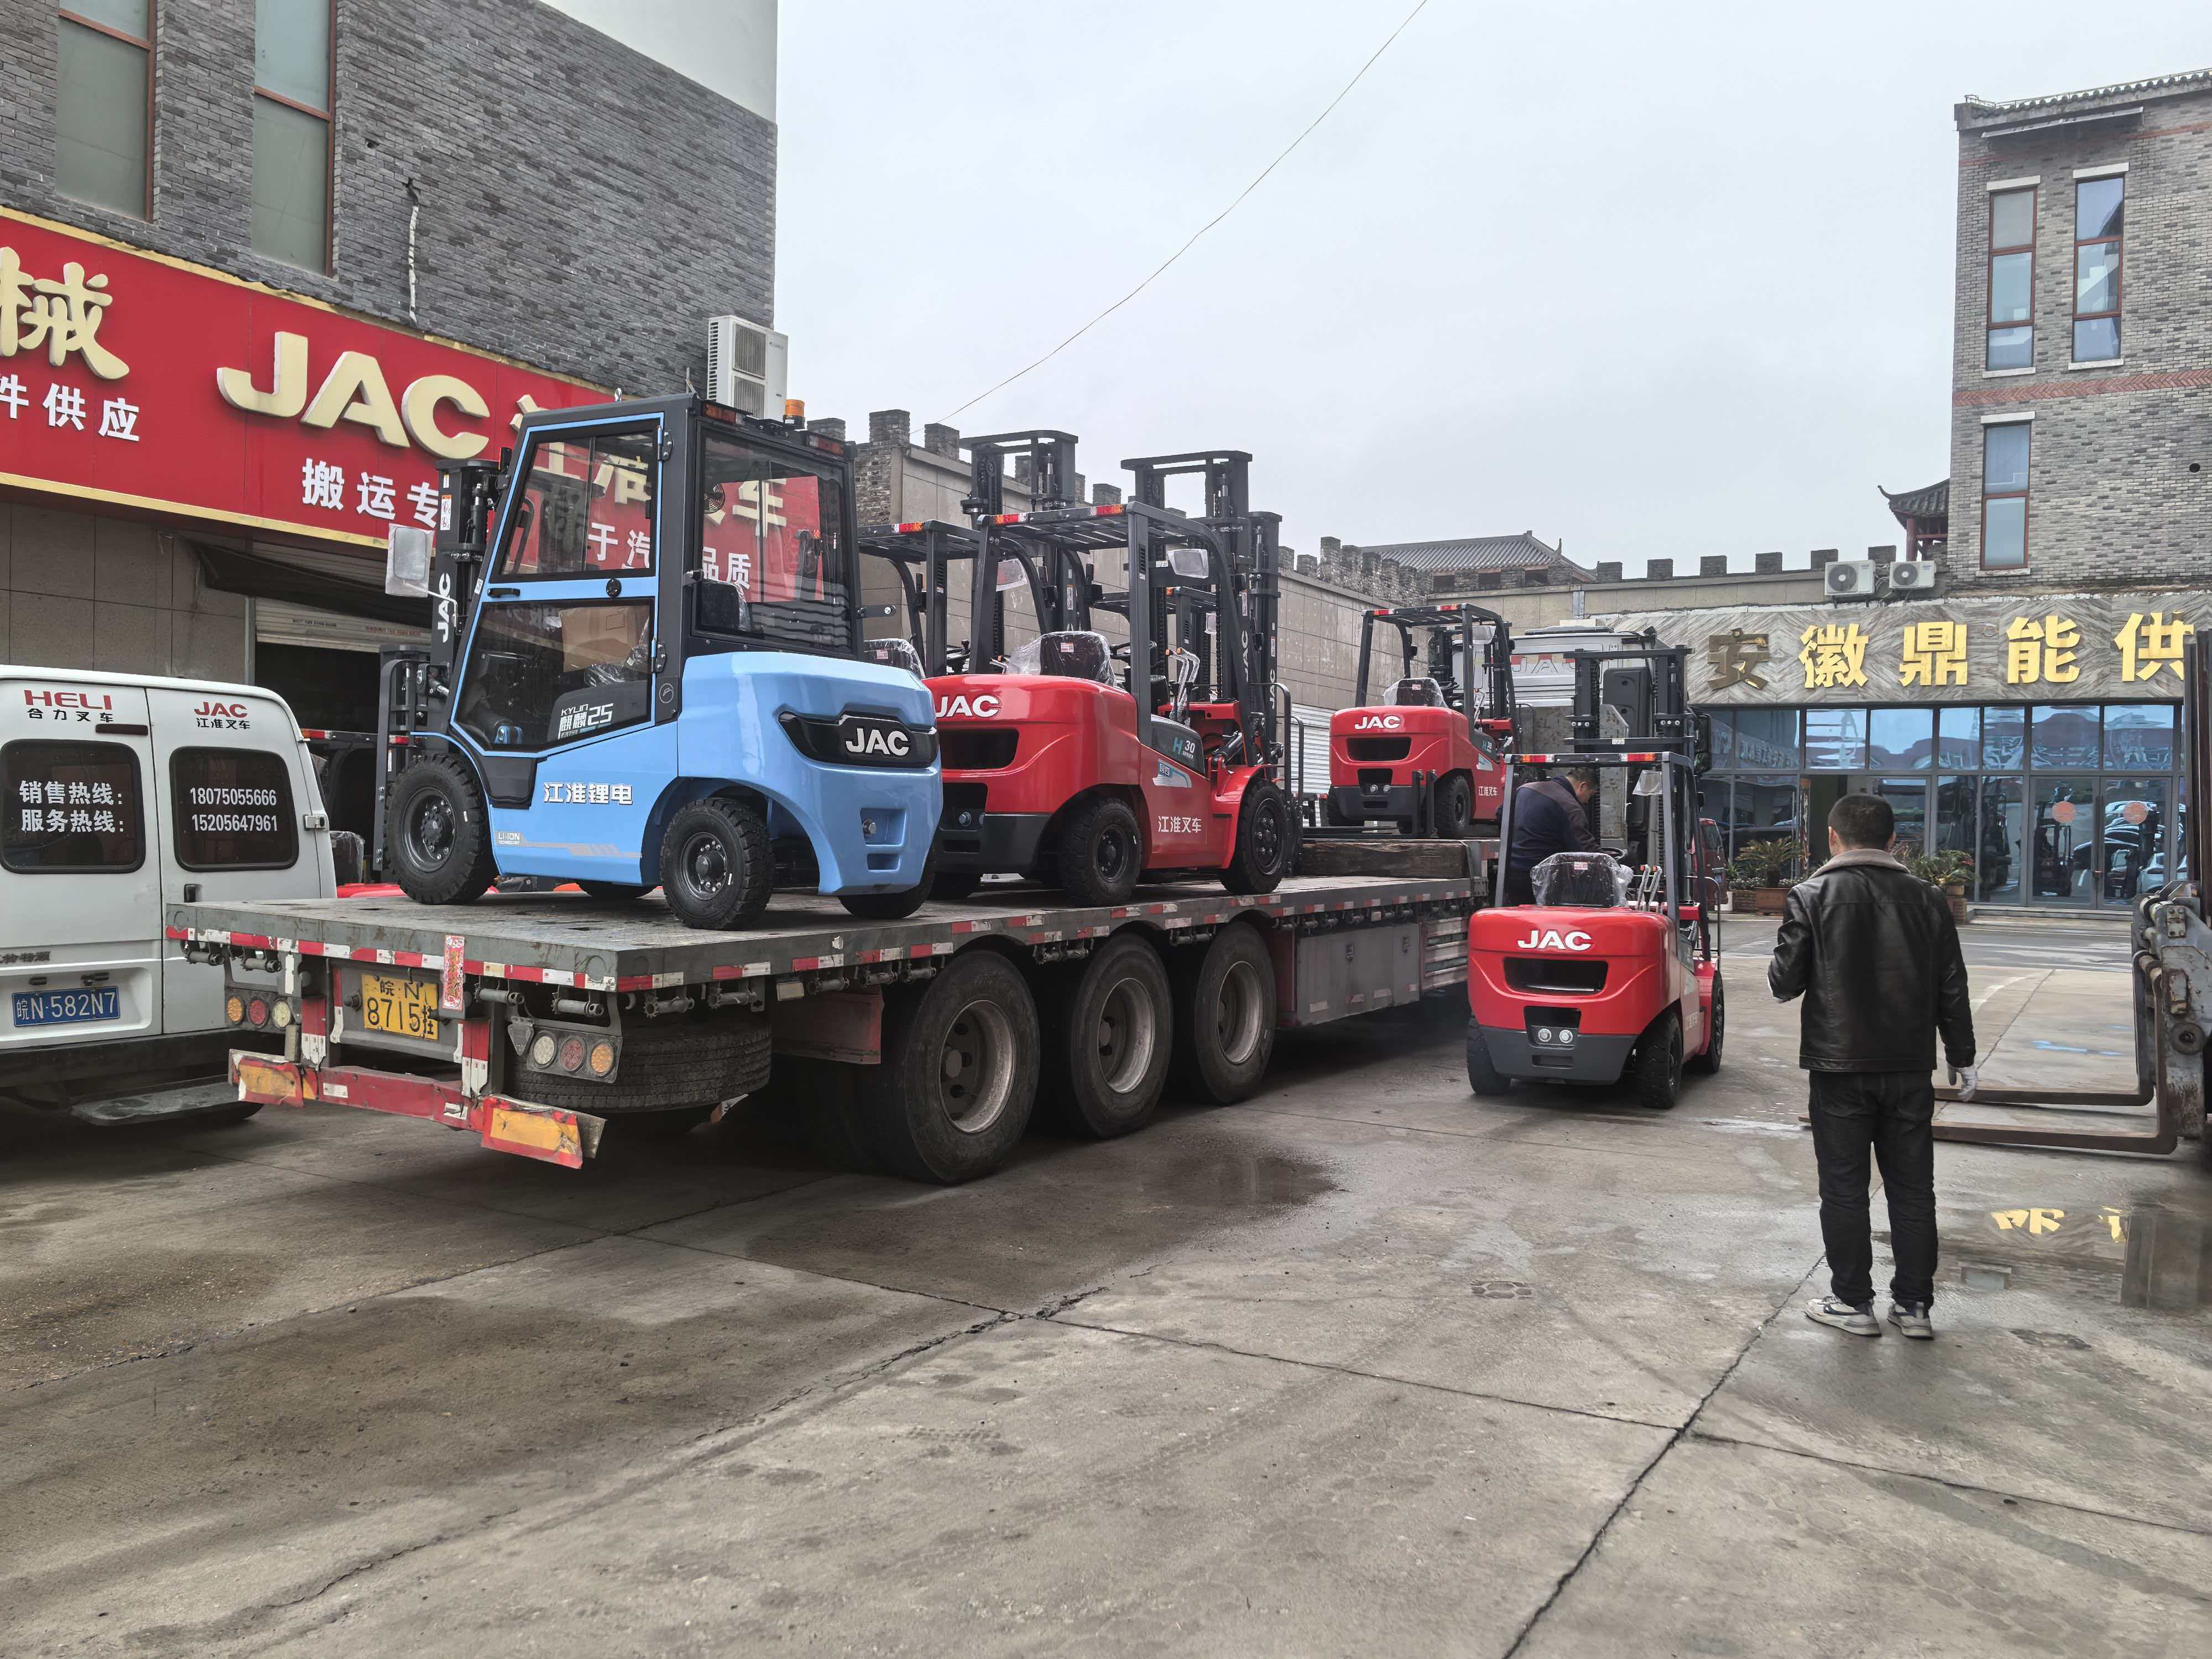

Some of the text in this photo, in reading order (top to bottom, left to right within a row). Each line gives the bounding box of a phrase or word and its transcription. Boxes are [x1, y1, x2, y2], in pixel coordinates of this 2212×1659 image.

[216, 331, 489, 459] JAC
[437, 572, 451, 643] JAC
[1707, 612, 2194, 691] 安徽鼎能供
[24, 690, 112, 710] HELI
[194, 701, 248, 718] JAC
[936, 695, 1001, 718] JAC
[27, 708, 114, 723] 合力叉车
[196, 718, 251, 729] 江淮叉车
[587, 703, 614, 726] 25
[1354, 716, 1402, 729] JAC
[845, 728, 910, 756] JAC
[1172, 737, 1184, 755] H
[1185, 740, 1196, 754] 30
[190, 787, 277, 806] 18075055666
[544, 782, 633, 805] 江淮锂电
[192, 814, 278, 832] 15205647961
[1158, 816, 1202, 833] 江淮叉车
[1517, 930, 1594, 951] JAC
